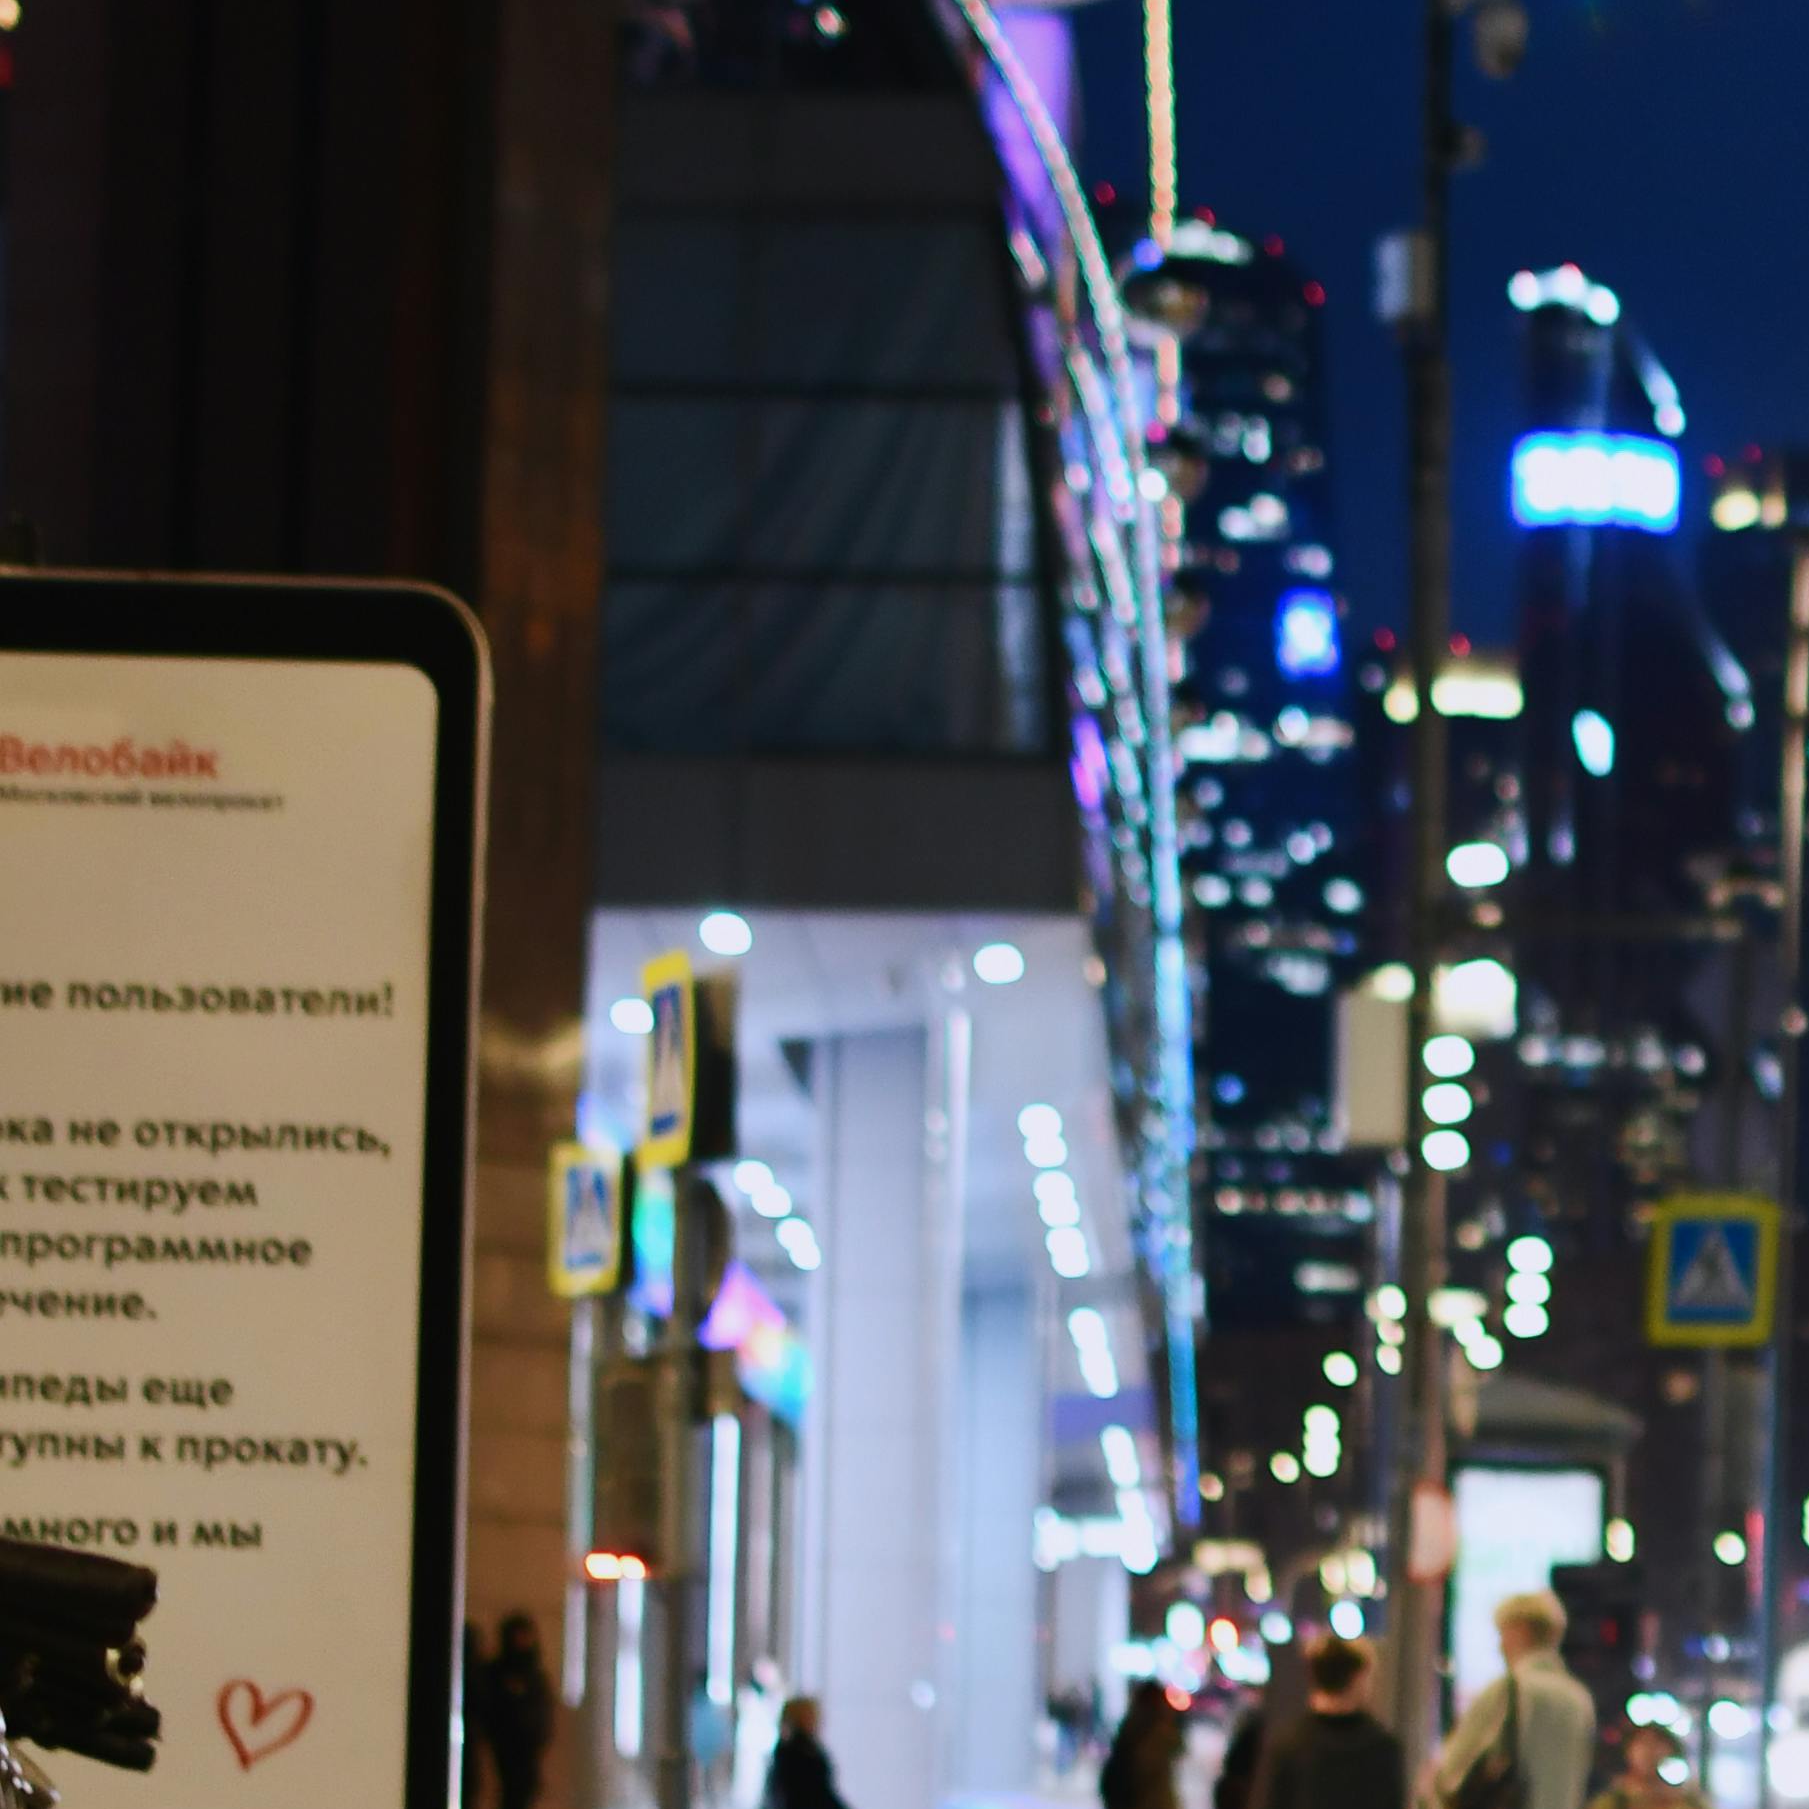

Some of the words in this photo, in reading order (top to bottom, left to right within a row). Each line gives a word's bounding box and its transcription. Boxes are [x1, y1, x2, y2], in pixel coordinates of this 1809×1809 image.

[0, 735, 217, 777] Велобайк
[67, 980, 393, 1016] пользователи!
[0, 1117, 54, 1145] ка
[69, 1119, 120, 1147] не
[134, 1119, 391, 1160] открылись,
[21, 1174, 258, 1215] тестируем
[0, 1373, 128, 1406] педы
[142, 1377, 234, 1410] еще
[140, 1435, 162, 1462] к
[177, 1435, 368, 1476] прокату.
[152, 1520, 178, 1546] и
[194, 1522, 263, 1549] мы
